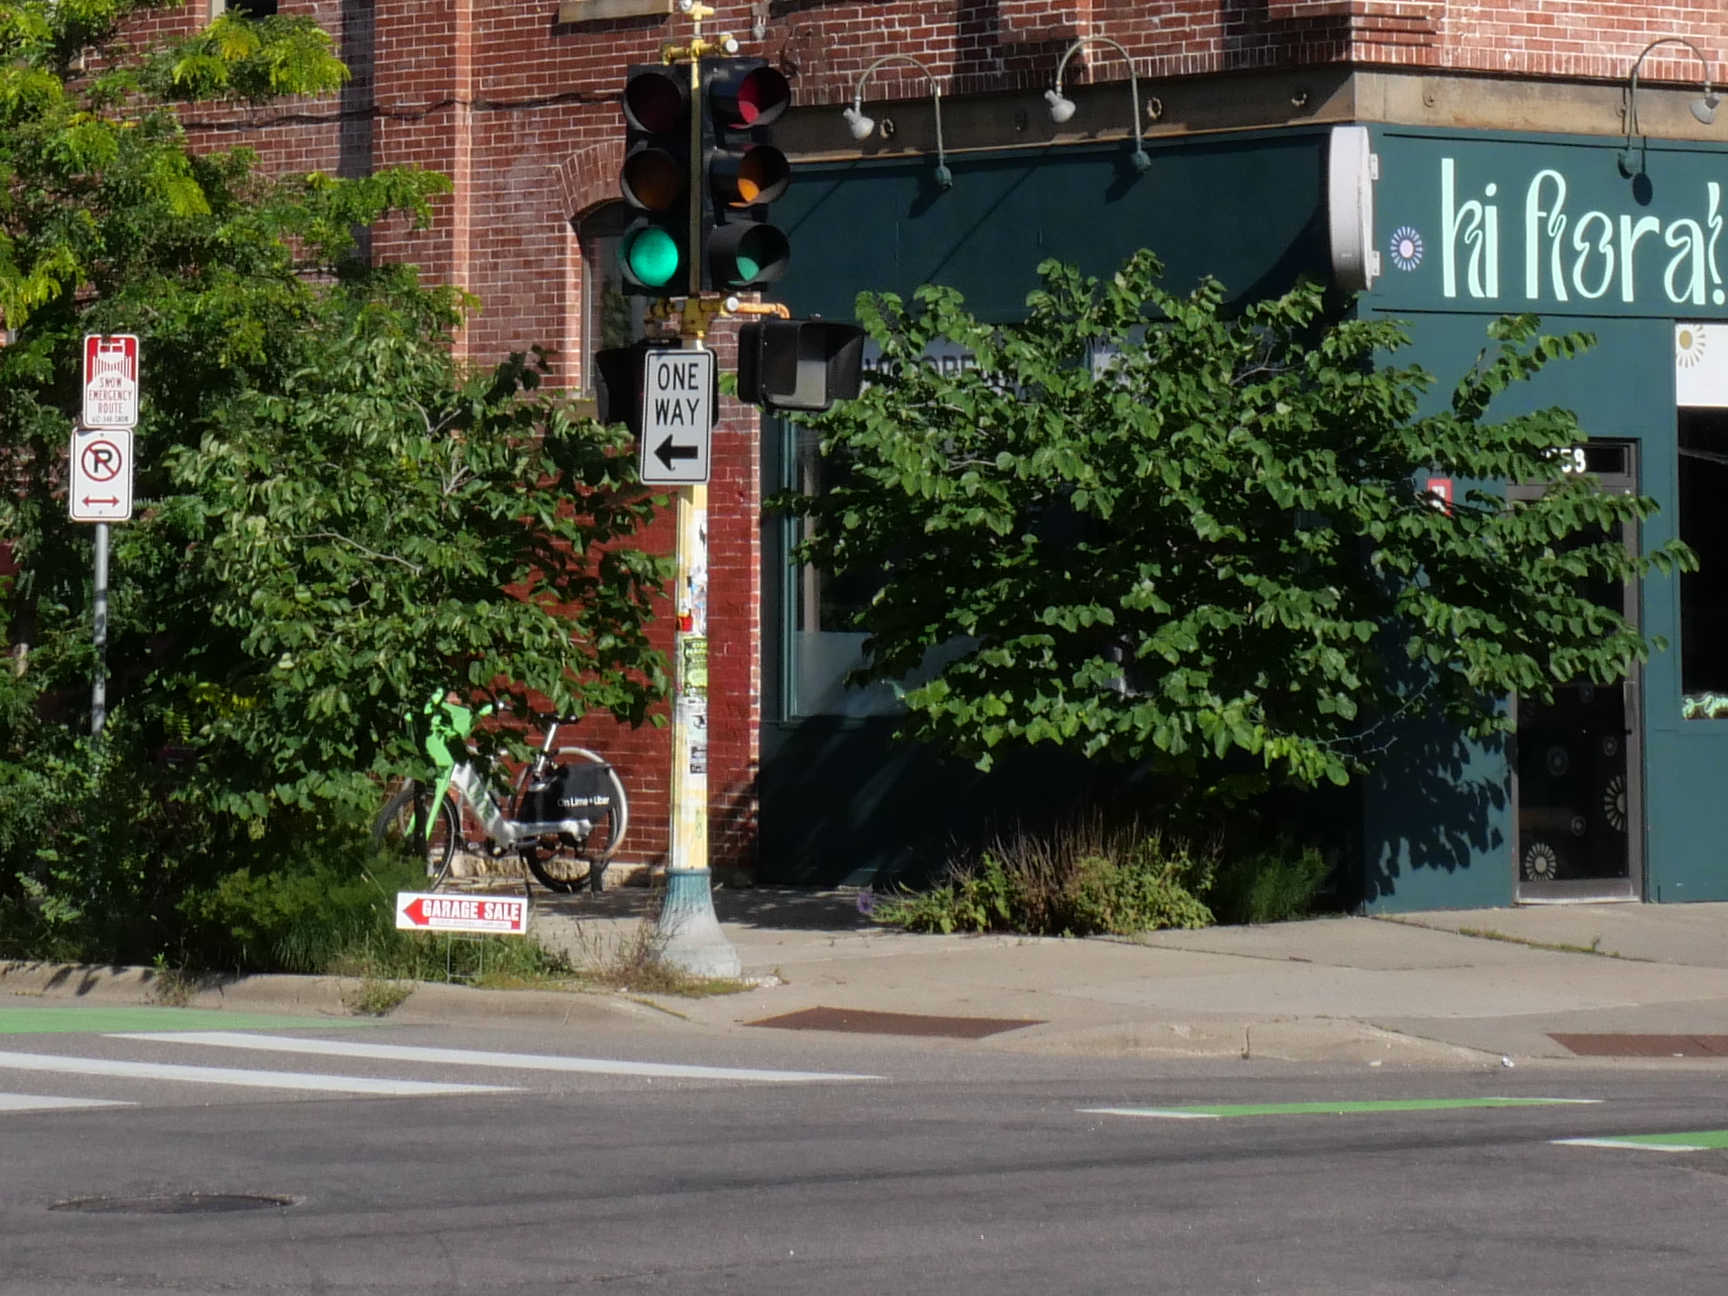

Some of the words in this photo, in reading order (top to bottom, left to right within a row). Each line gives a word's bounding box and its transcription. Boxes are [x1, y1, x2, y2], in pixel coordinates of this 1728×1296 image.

[1441, 158, 1499, 298] hi
[100, 377, 122, 388] SNOW
[658, 362, 699, 390] ONE
[88, 389, 132, 401] EMERGENCY
[98, 402, 123, 414] ROUTE
[655, 398, 700, 426] WAY
[422, 899, 479, 919] GARAGE
[484, 902, 519, 921] SALE
